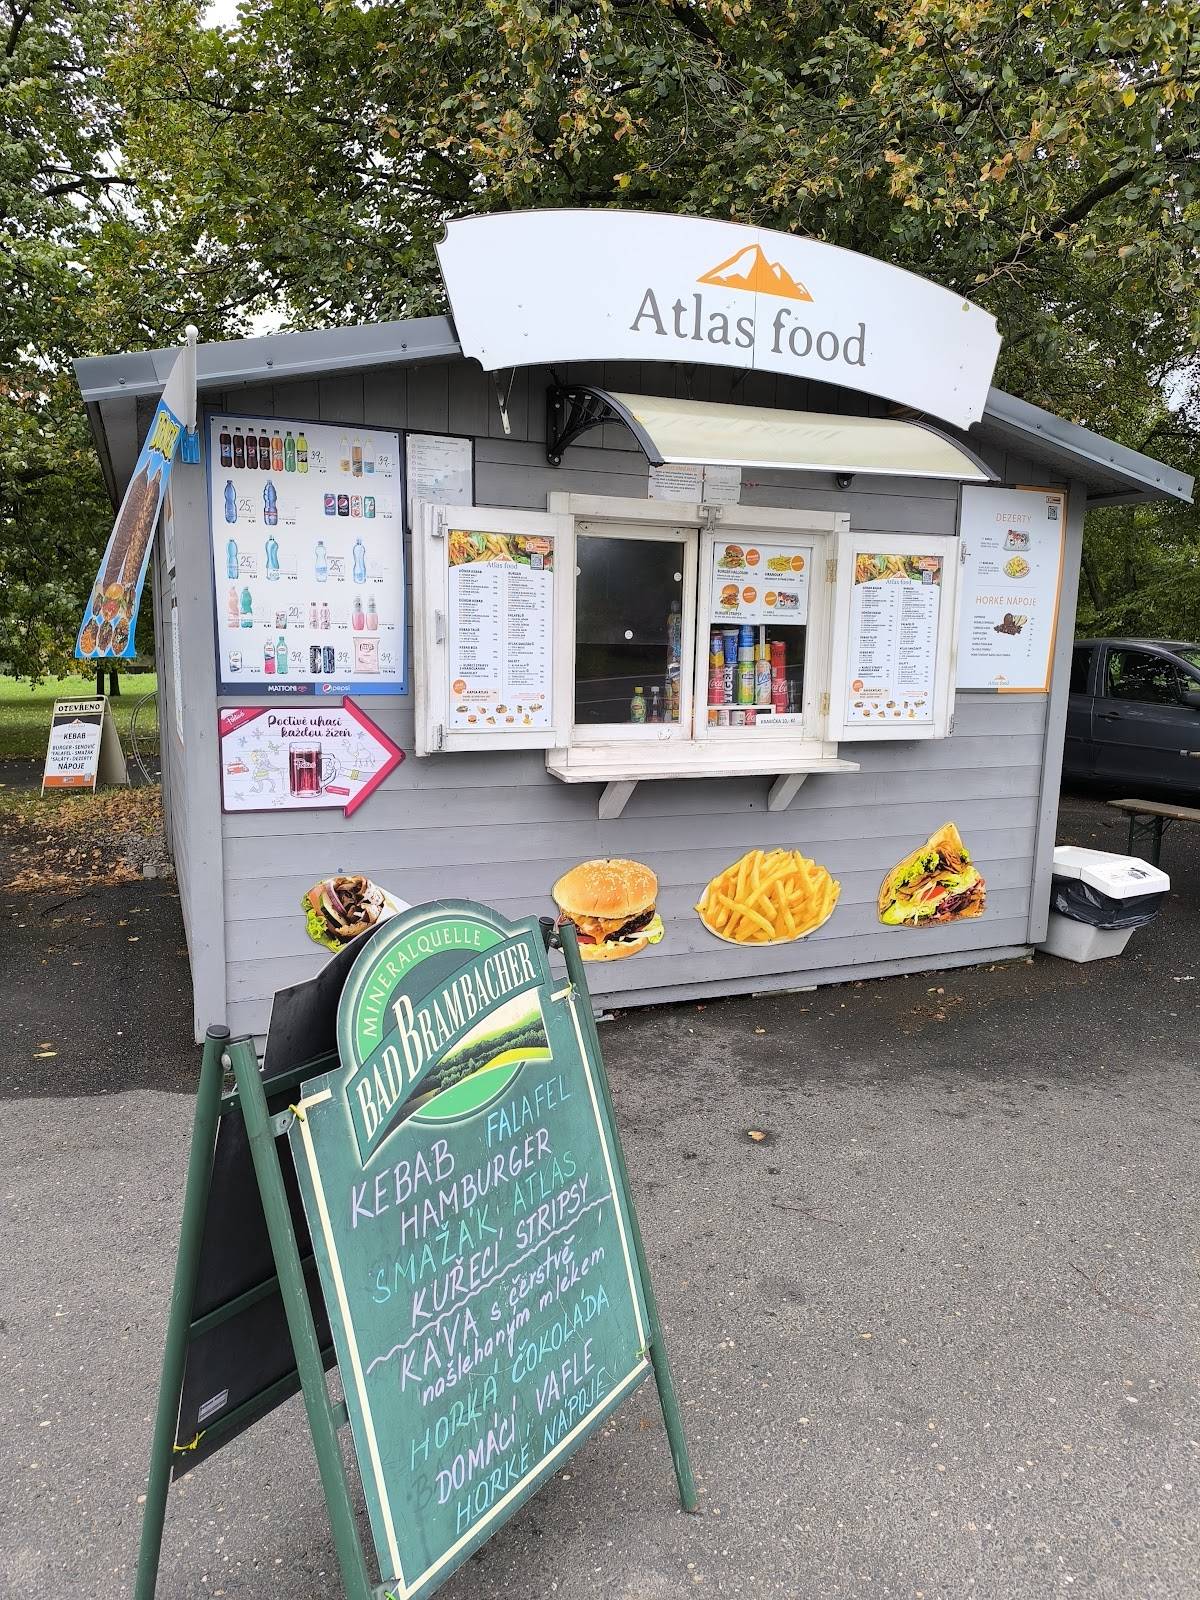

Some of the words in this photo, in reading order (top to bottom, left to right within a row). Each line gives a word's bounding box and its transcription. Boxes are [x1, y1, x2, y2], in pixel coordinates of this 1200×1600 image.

[629, 287, 756, 349] Atlas
[771, 308, 867, 368] food
[995, 512, 1032, 523] DEZERTY
[58, 704, 100, 712] OTEVŘENO
[281, 727, 323, 738] každou
[58, 762, 85, 770] NÁPOJE
[362, 927, 482, 1038] MINERALQUELLE
[355, 1044, 403, 1142] BAD
[391, 941, 538, 1084] BRAMBACHER
[352, 1139, 455, 1229] KEBAB
[487, 1074, 571, 1148] FALAFEL
[401, 1127, 552, 1246] HAMBURGER
[513, 1150, 577, 1216] ATLAS
[412, 1226, 504, 1329] KUŘECÍ
[516, 1172, 589, 1250] STRIPSY
[401, 1307, 479, 1392] KÁVA
[410, 1359, 498, 1471] HORKÁ
[511, 1284, 610, 1384] ČOKOLÁDA
[435, 1395, 517, 1505] DOMÁCÍ
[536, 1337, 597, 1416] VAFLE
[456, 1424, 530, 1534] HORKÉ
[542, 1366, 608, 1455] NÁPOJE
